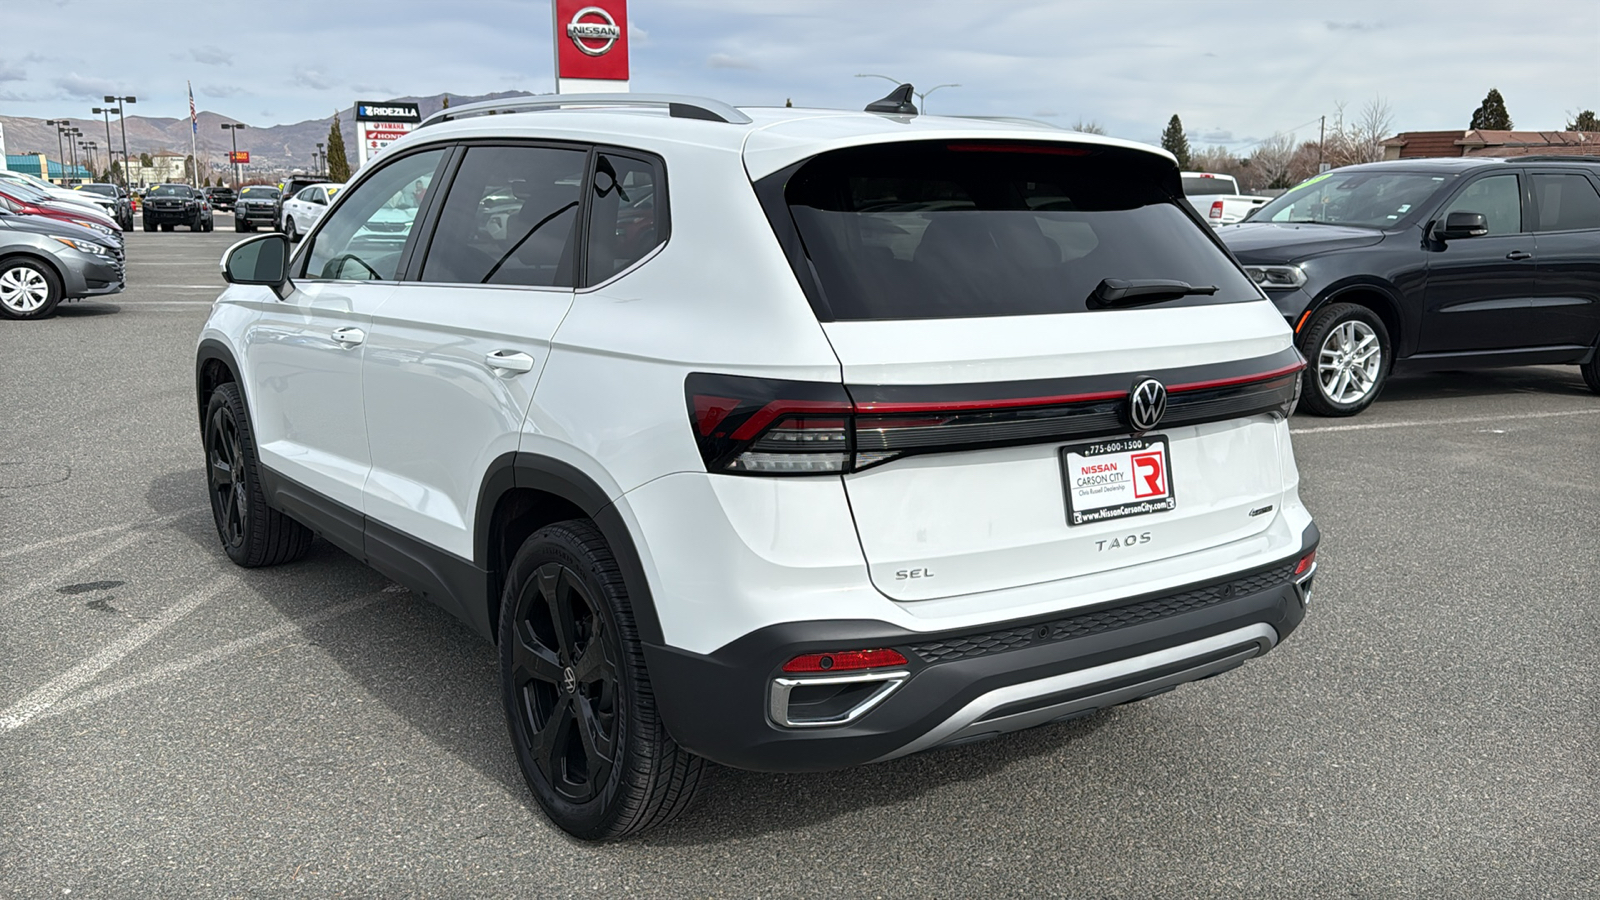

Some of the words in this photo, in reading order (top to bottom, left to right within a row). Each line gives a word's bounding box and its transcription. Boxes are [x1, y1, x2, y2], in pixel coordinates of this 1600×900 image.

[573, 26, 616, 36] NISSAN
[373, 107, 418, 117] RIDEZILLA
[1090, 440, 1142, 454] 775-600-1500
[1081, 463, 1117, 475] NISSAN
[1077, 476, 1108, 487] CARSON
[1109, 472, 1125, 482] CITY
[1104, 485, 1126, 493] Dealership
[1082, 503, 1166, 522] www.NissanCarsonCity.com
[1095, 532, 1151, 552] TAOS
[895, 568, 934, 580] SEL
